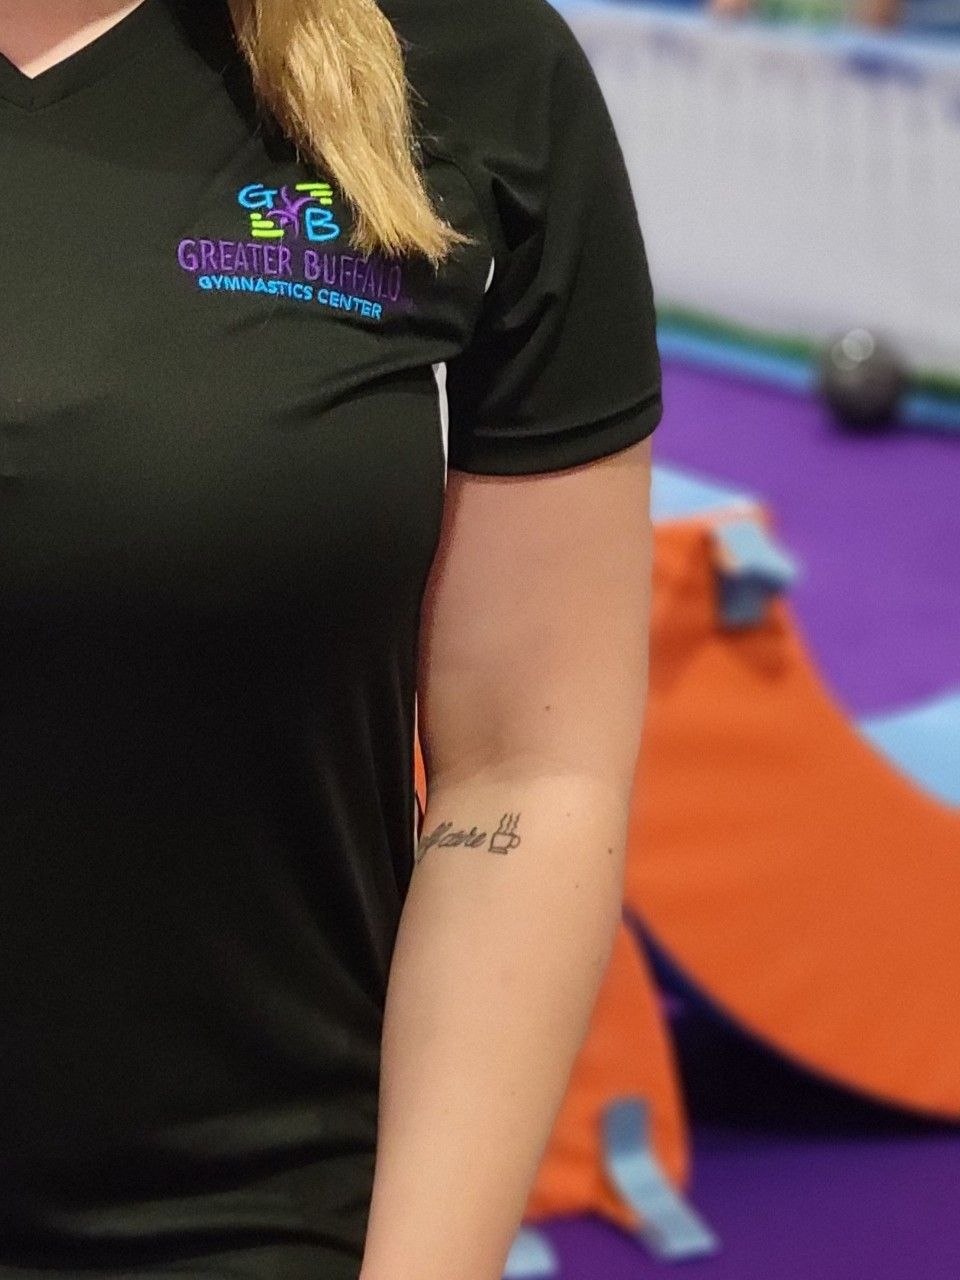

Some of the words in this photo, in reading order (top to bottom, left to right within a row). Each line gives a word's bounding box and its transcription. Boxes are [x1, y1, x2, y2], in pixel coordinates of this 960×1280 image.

[177, 239, 293, 276] GREATER
[303, 249, 401, 302] BUFFALO
[198, 275, 313, 301] GYMNASTICS
[317, 288, 382, 320] CENTER
